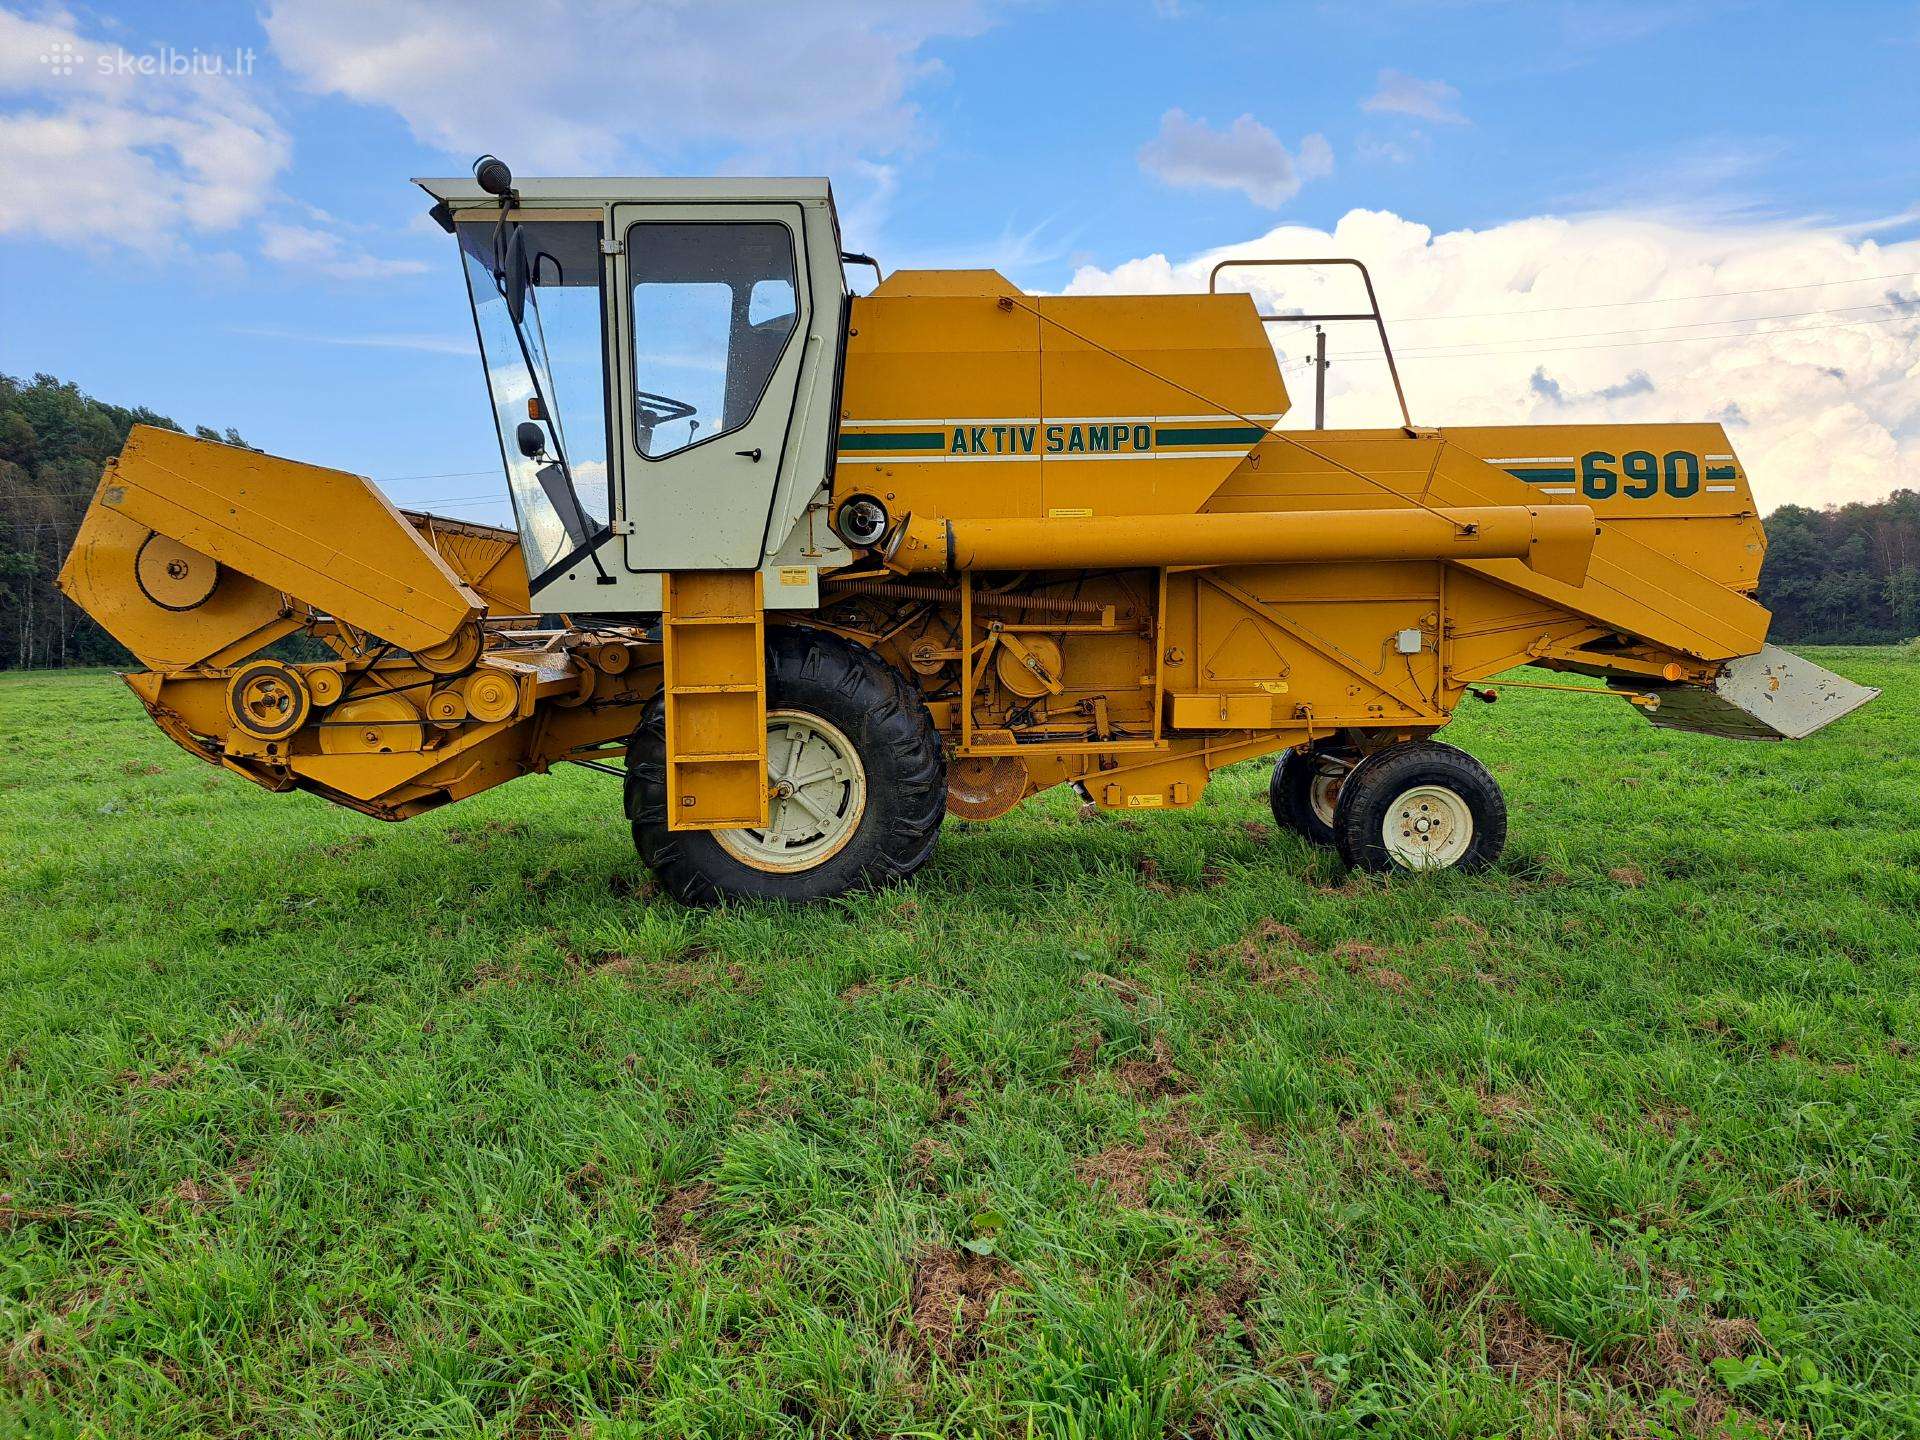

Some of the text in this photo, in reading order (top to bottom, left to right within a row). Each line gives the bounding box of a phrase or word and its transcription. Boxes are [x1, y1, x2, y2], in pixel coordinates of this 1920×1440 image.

[950, 424, 1152, 454] AKTIV SAMPO
[1580, 450, 1700, 500] 690
